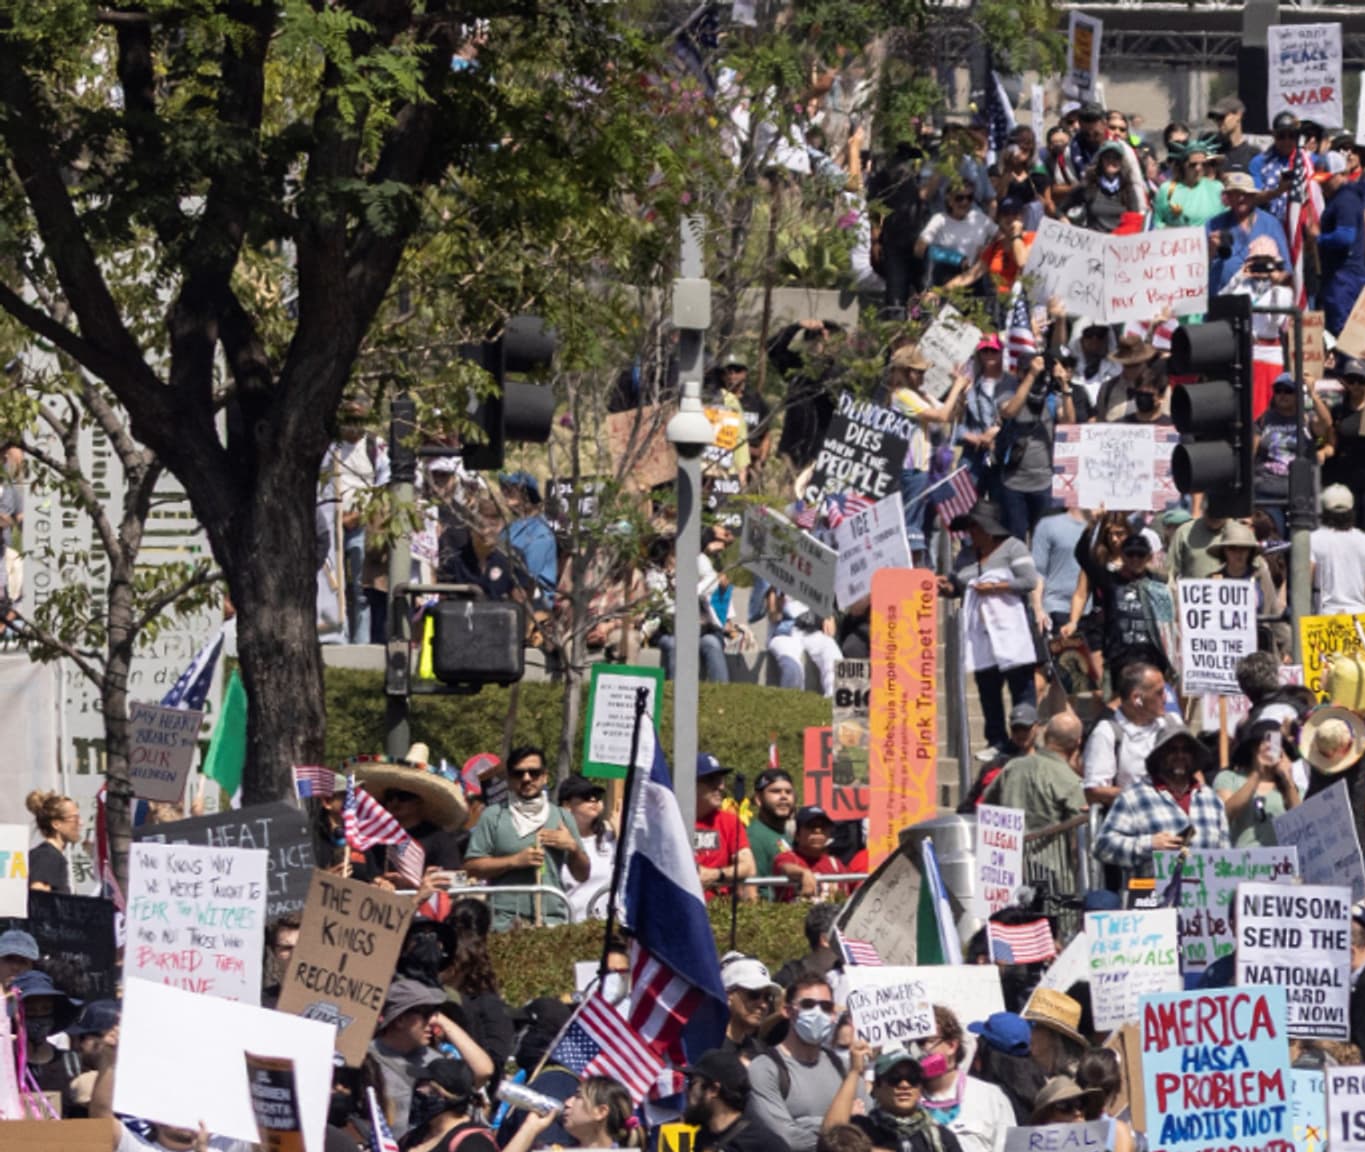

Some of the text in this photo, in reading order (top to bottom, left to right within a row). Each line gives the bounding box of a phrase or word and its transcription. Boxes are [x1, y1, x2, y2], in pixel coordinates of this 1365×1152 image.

[1282, 87, 1335, 105] WAR
[844, 422, 883, 451] DIES
[816, 450, 893, 497] PEOPLE
[1183, 586, 1249, 606] ICE OUT
[1187, 609, 1247, 630] OF LA!
[1191, 639, 1243, 653] END THE
[917, 579, 935, 759] Pink Trumpet Tree
[982, 829, 1019, 851] ILLEGAL
[320, 881, 409, 932] THE ONLY
[1243, 895, 1348, 920] NEWSOM:
[321, 920, 376, 956] KINGS
[1243, 928, 1348, 951] SEND THE
[297, 961, 384, 1011] RECOGNIZE
[1245, 965, 1342, 988] NATIONAL
[1143, 994, 1276, 1052] AMERICA
[1155, 1069, 1286, 1114] PROBLEM
[1242, 1105, 1286, 1137] NOT
[1028, 1129, 1098, 1152] REAL
